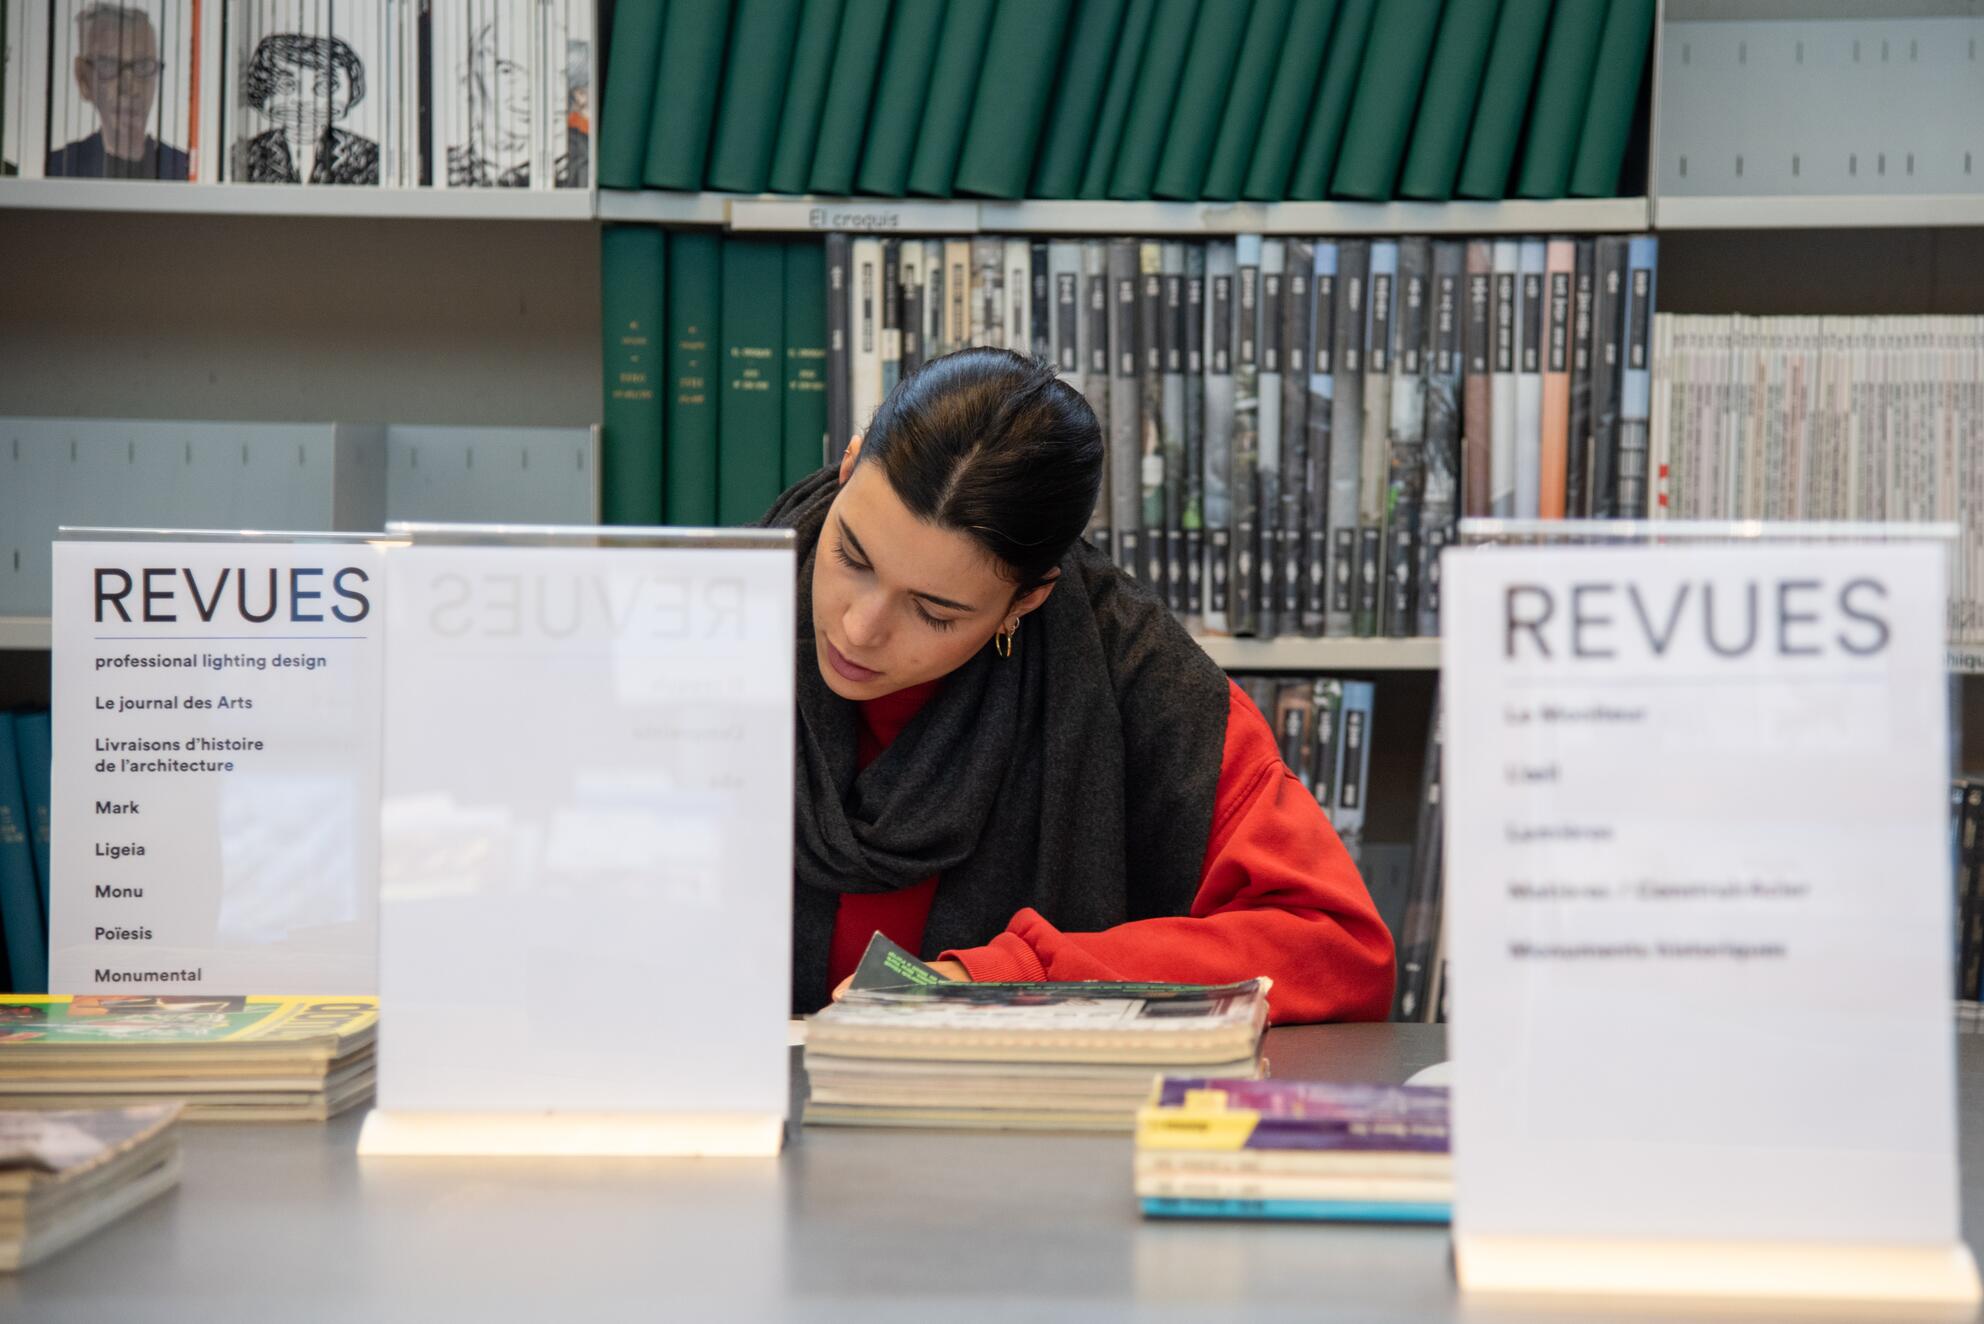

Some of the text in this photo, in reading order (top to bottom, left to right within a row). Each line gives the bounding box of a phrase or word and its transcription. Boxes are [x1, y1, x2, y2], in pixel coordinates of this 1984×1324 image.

[809, 207, 900, 231] El croquis
[94, 567, 371, 623] REVUES
[1503, 576, 1892, 661] REVUES
[95, 654, 327, 671] professional lighting design
[95, 696, 253, 713] Le journal des Arts
[95, 737, 265, 752] Livraisons d’histoire
[94, 758, 235, 773] de l’architecture
[95, 800, 140, 815] Mark
[95, 842, 146, 859] Ligeia
[95, 885, 144, 899] Monu
[95, 925, 153, 941] Poïesis
[95, 968, 202, 983] Monumental
